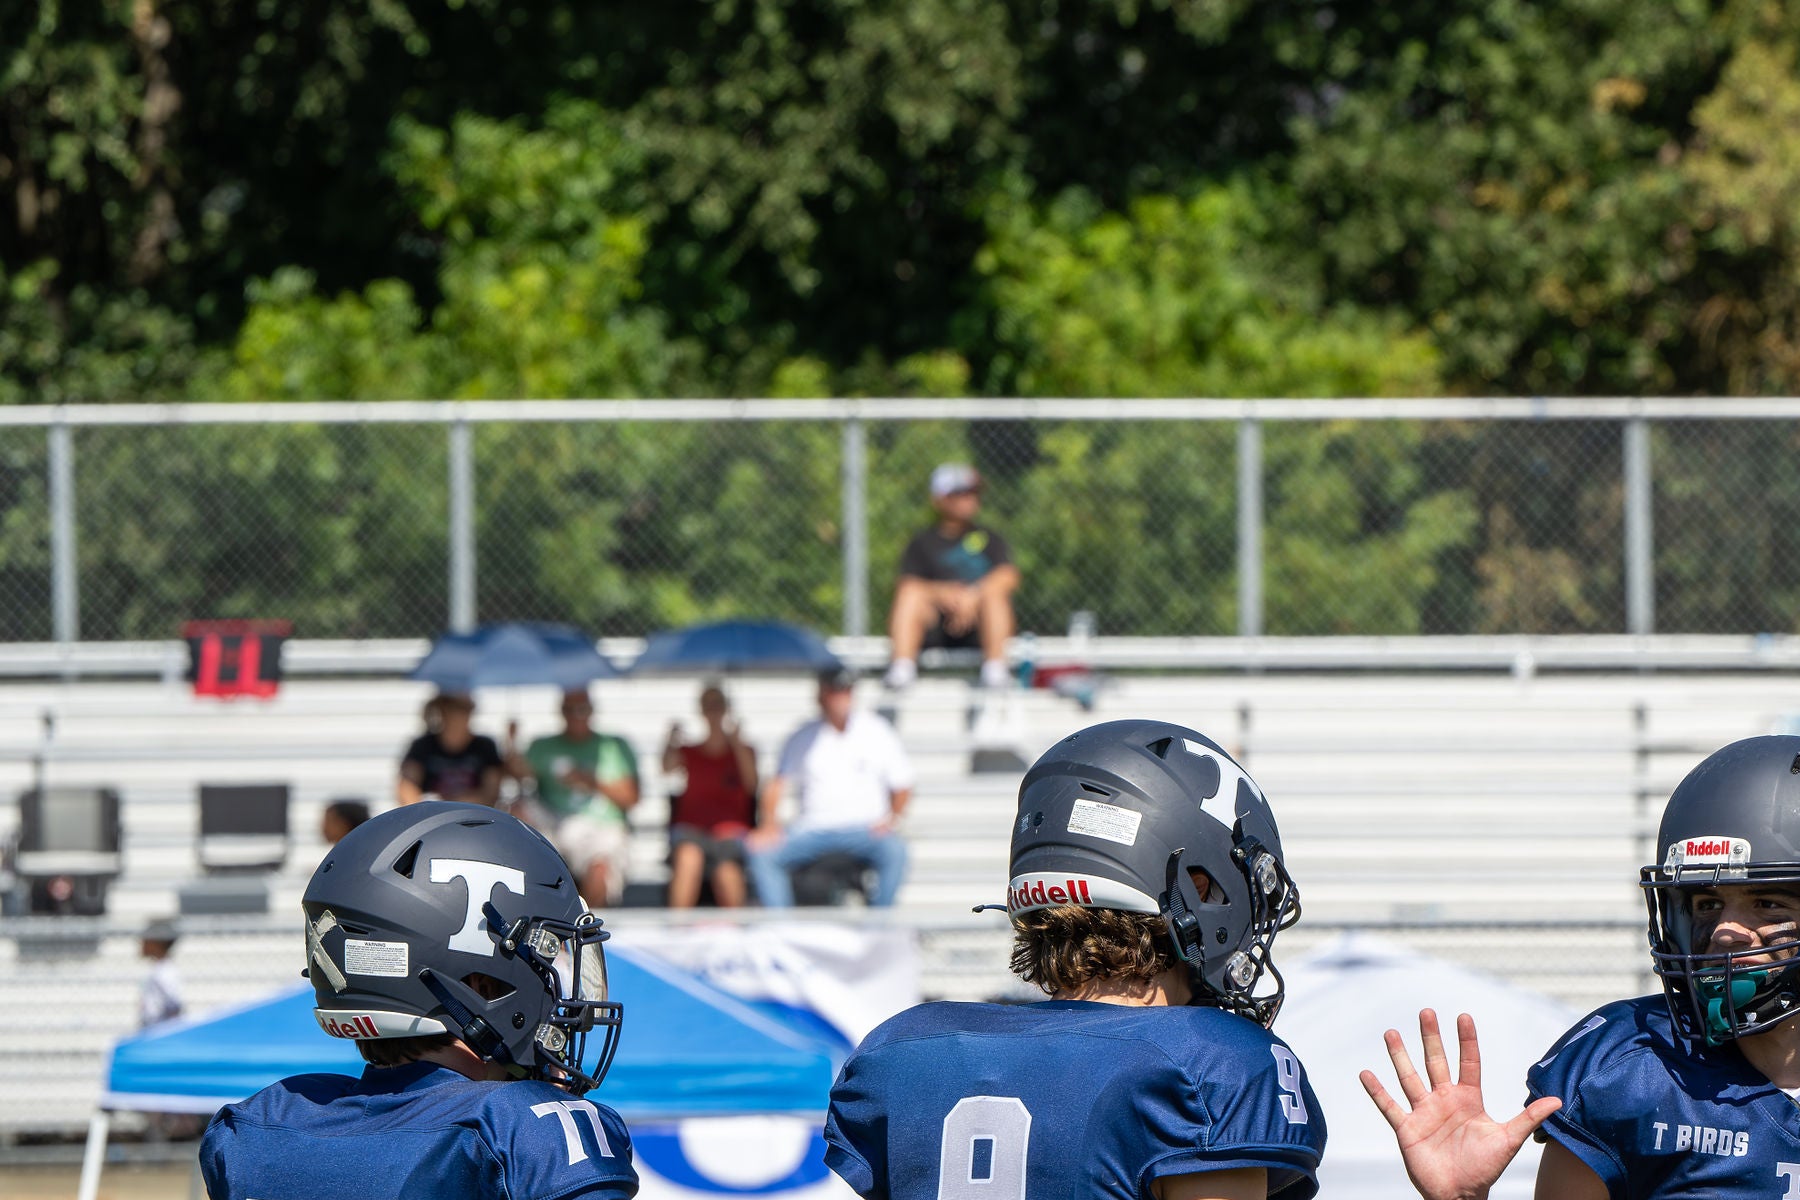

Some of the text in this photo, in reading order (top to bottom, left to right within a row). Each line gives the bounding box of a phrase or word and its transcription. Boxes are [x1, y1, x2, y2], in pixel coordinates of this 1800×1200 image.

[1181, 737, 1263, 832] T
[1686, 841, 1730, 857] Riddell
[429, 858, 526, 957] T
[1271, 1043, 1308, 1124] 9
[529, 1100, 614, 1166] 77
[1653, 1122, 1749, 1157] T BIRDS
